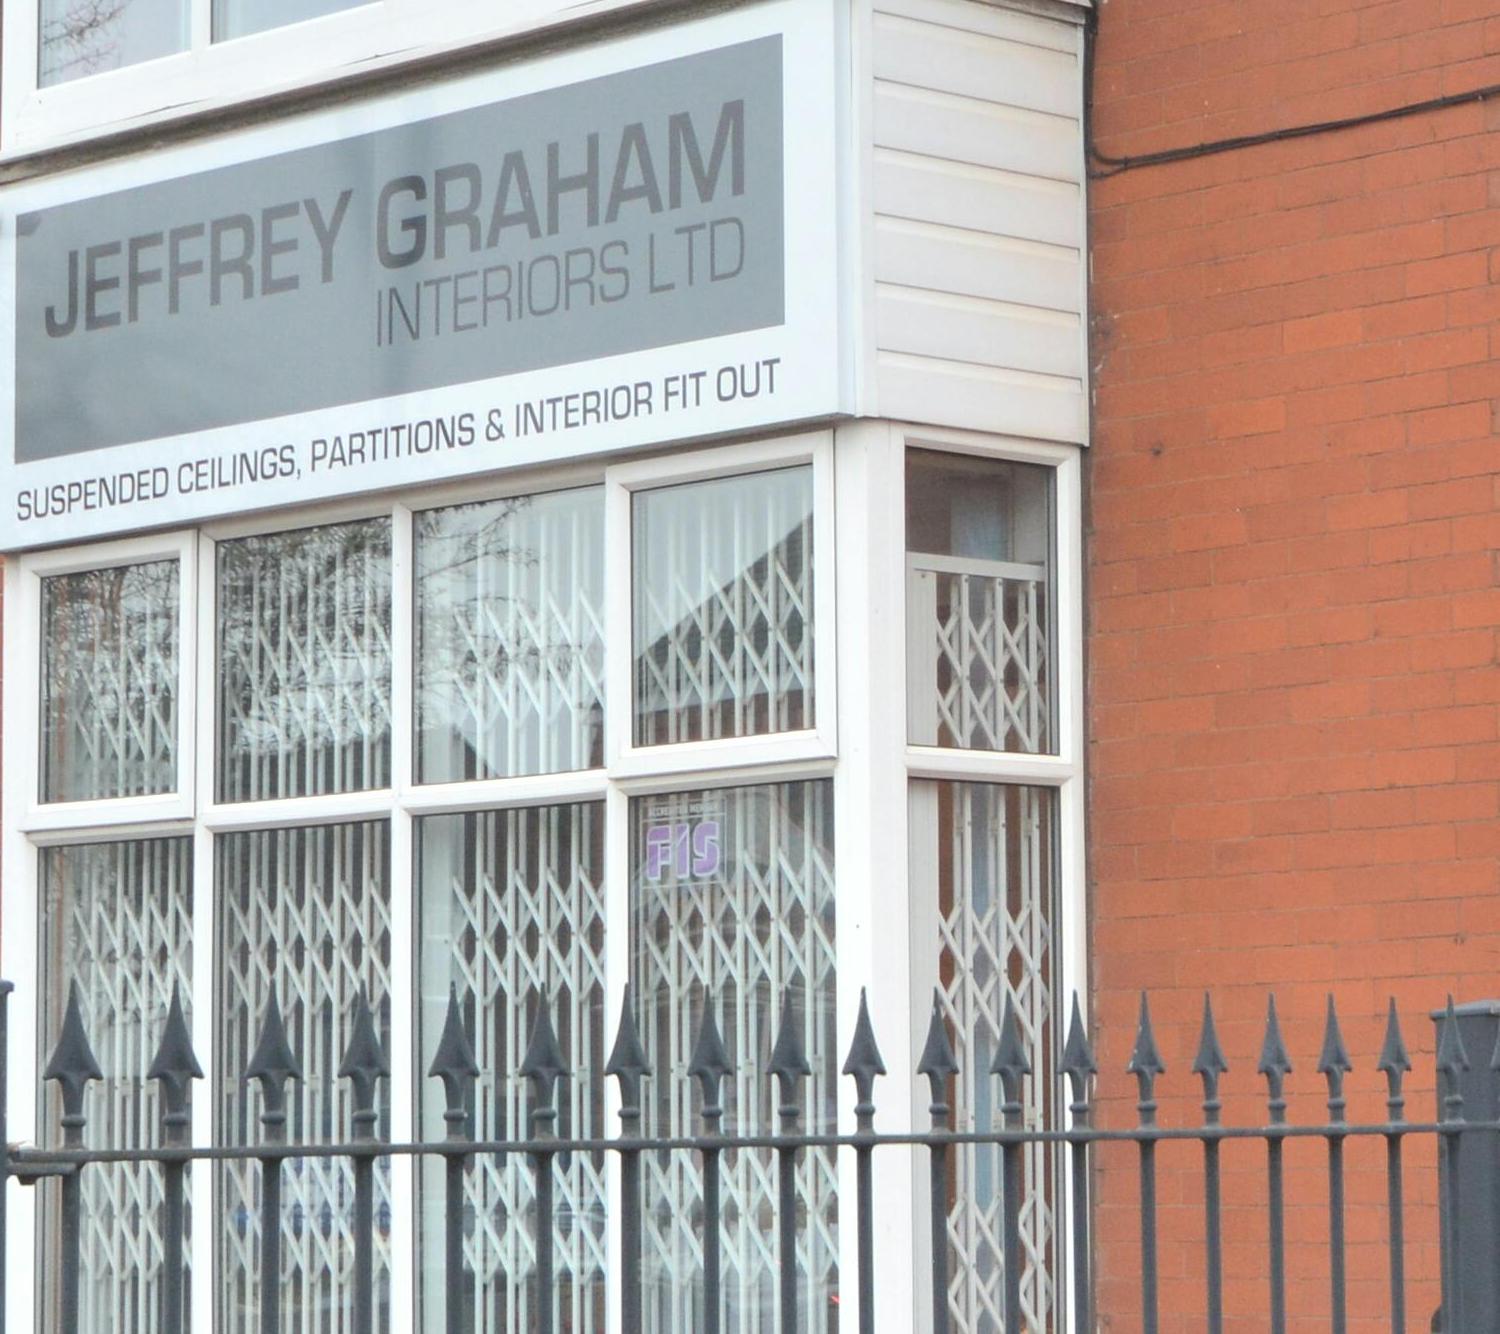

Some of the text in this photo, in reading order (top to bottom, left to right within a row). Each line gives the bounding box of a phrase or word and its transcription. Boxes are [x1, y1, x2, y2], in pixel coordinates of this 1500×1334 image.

[44, 99, 746, 339] JEFFREY GRAHAM
[376, 216, 746, 348] INTERIORS LTD
[16, 357, 781, 522] SUSPENDED CEILINGS, PARTITIONS & INTERIOR FIT OUT
[646, 821, 720, 881] FIS
